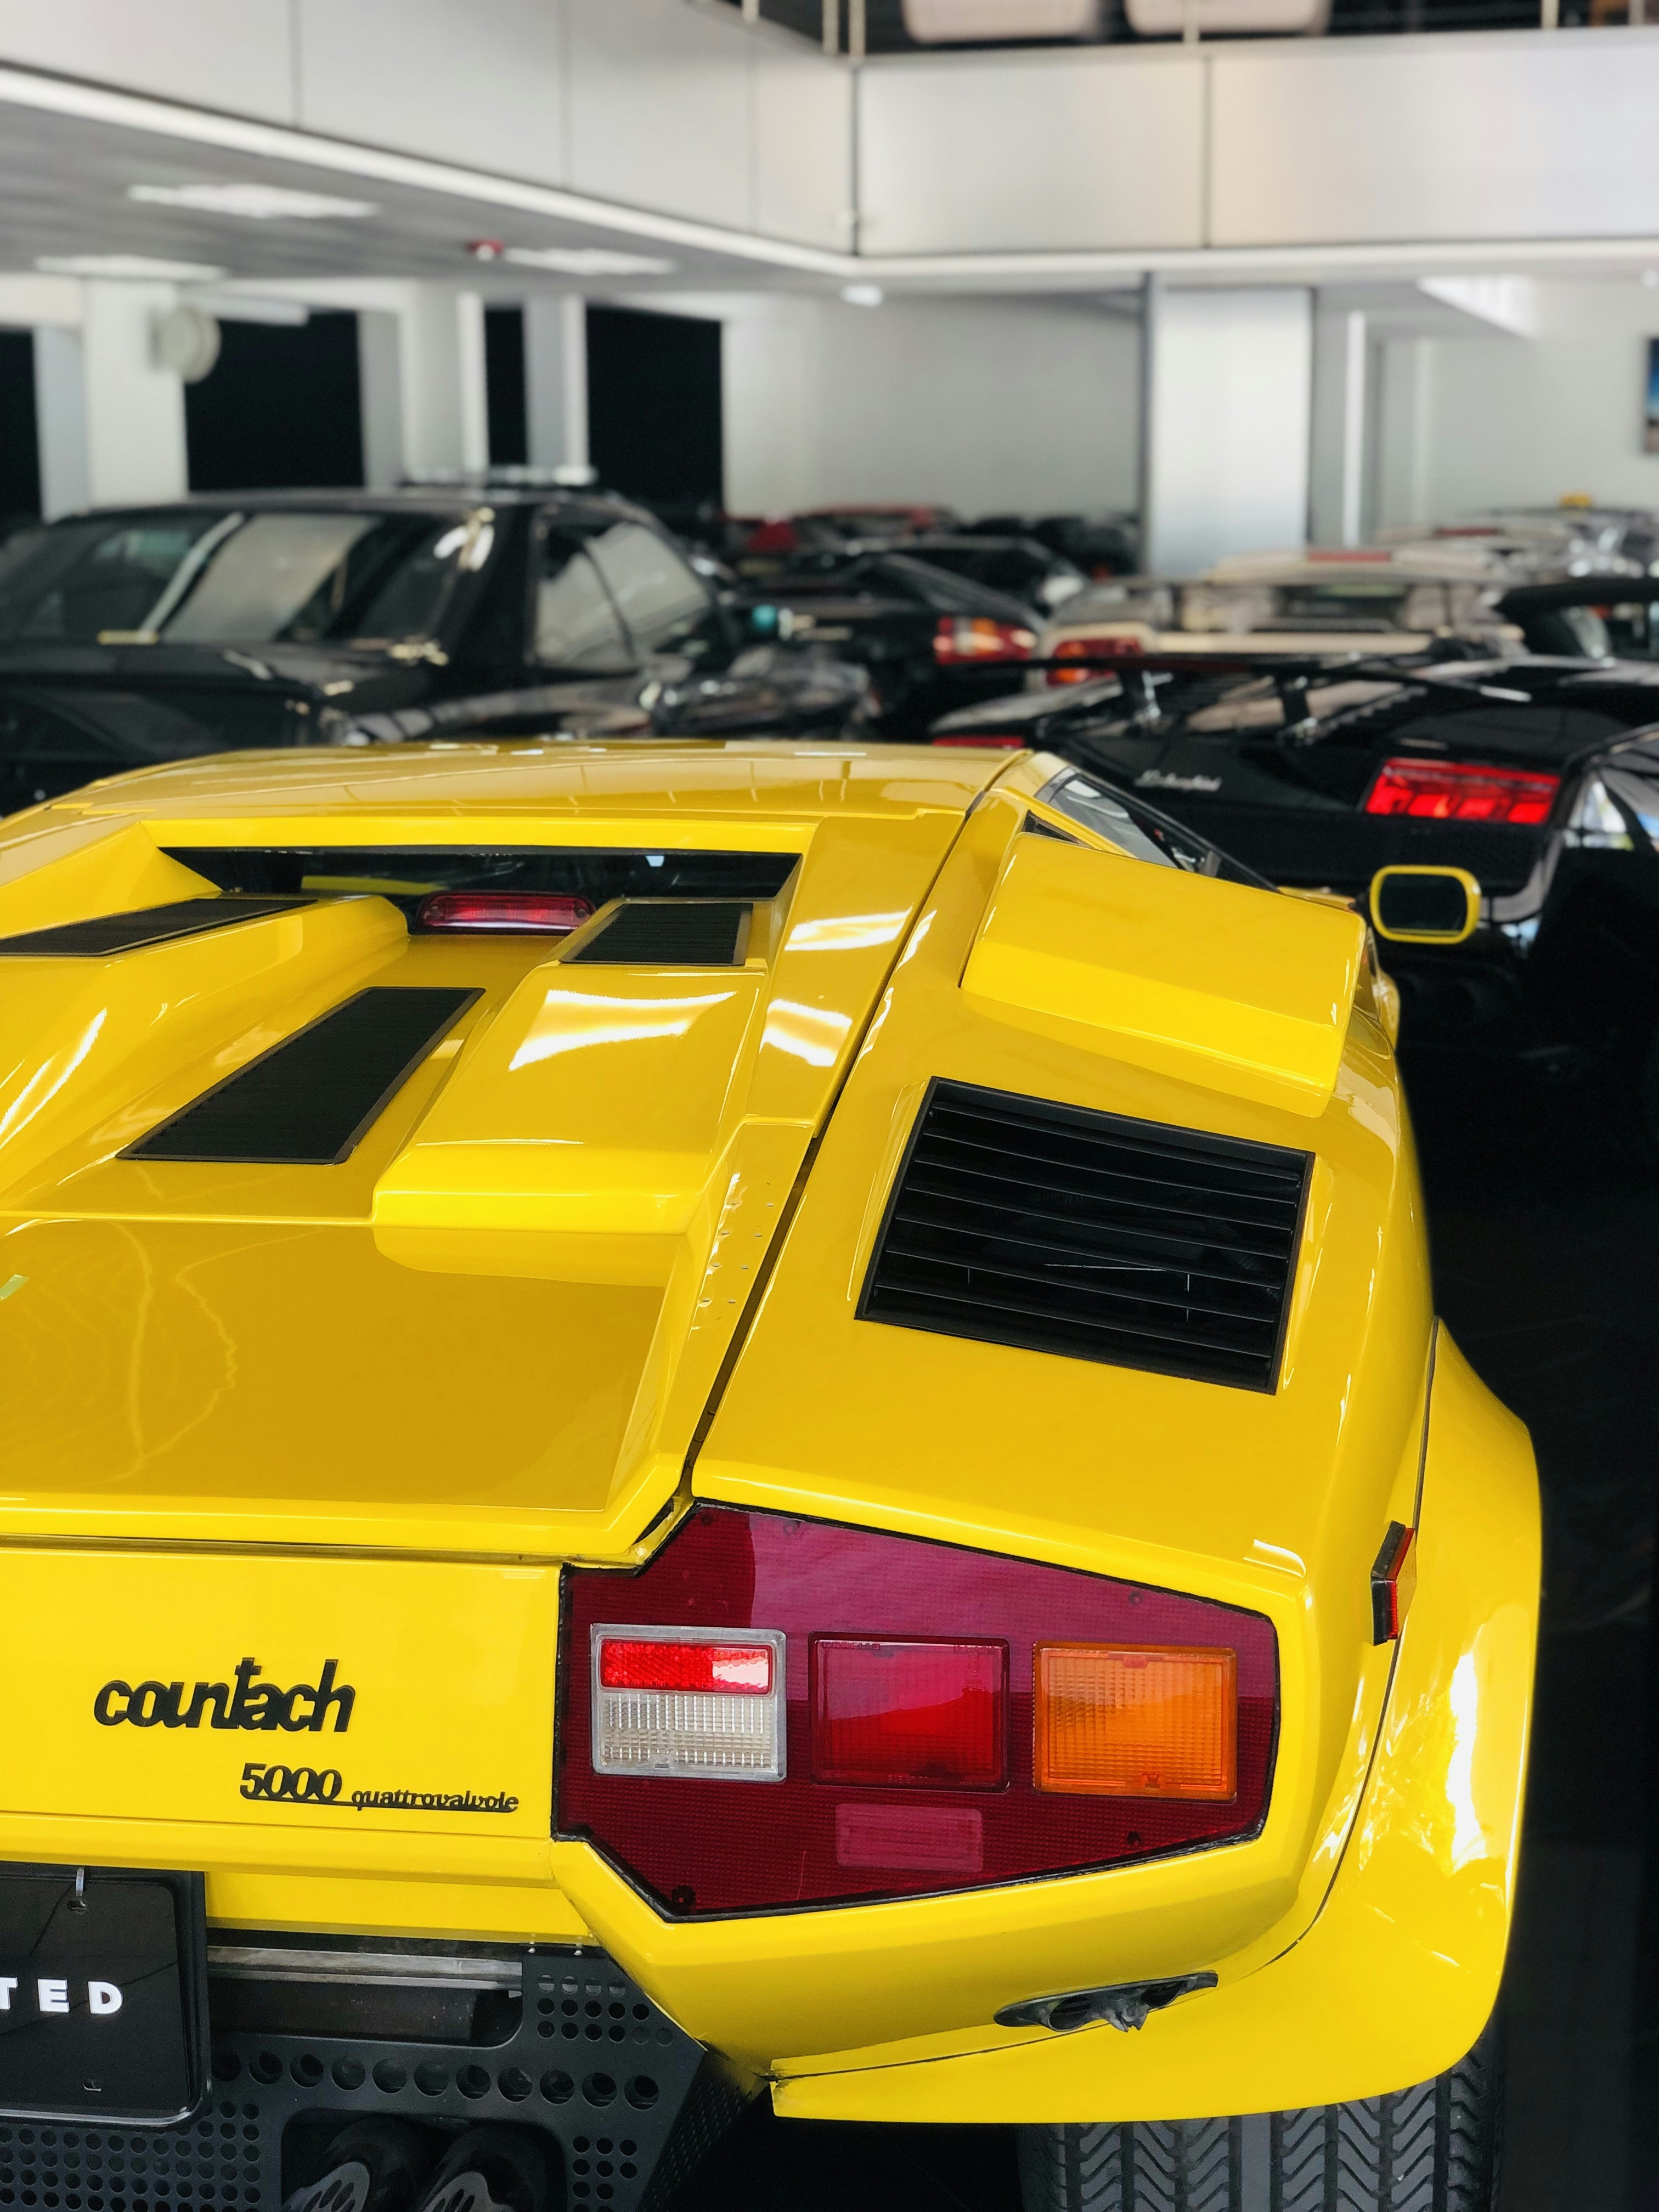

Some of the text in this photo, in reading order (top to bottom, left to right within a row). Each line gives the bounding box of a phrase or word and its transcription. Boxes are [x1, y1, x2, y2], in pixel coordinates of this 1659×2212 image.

[94, 1657, 356, 1733] countach
[240, 1763, 519, 1813] 5000 quattrovalvole
[0, 1977, 123, 2014] TED
